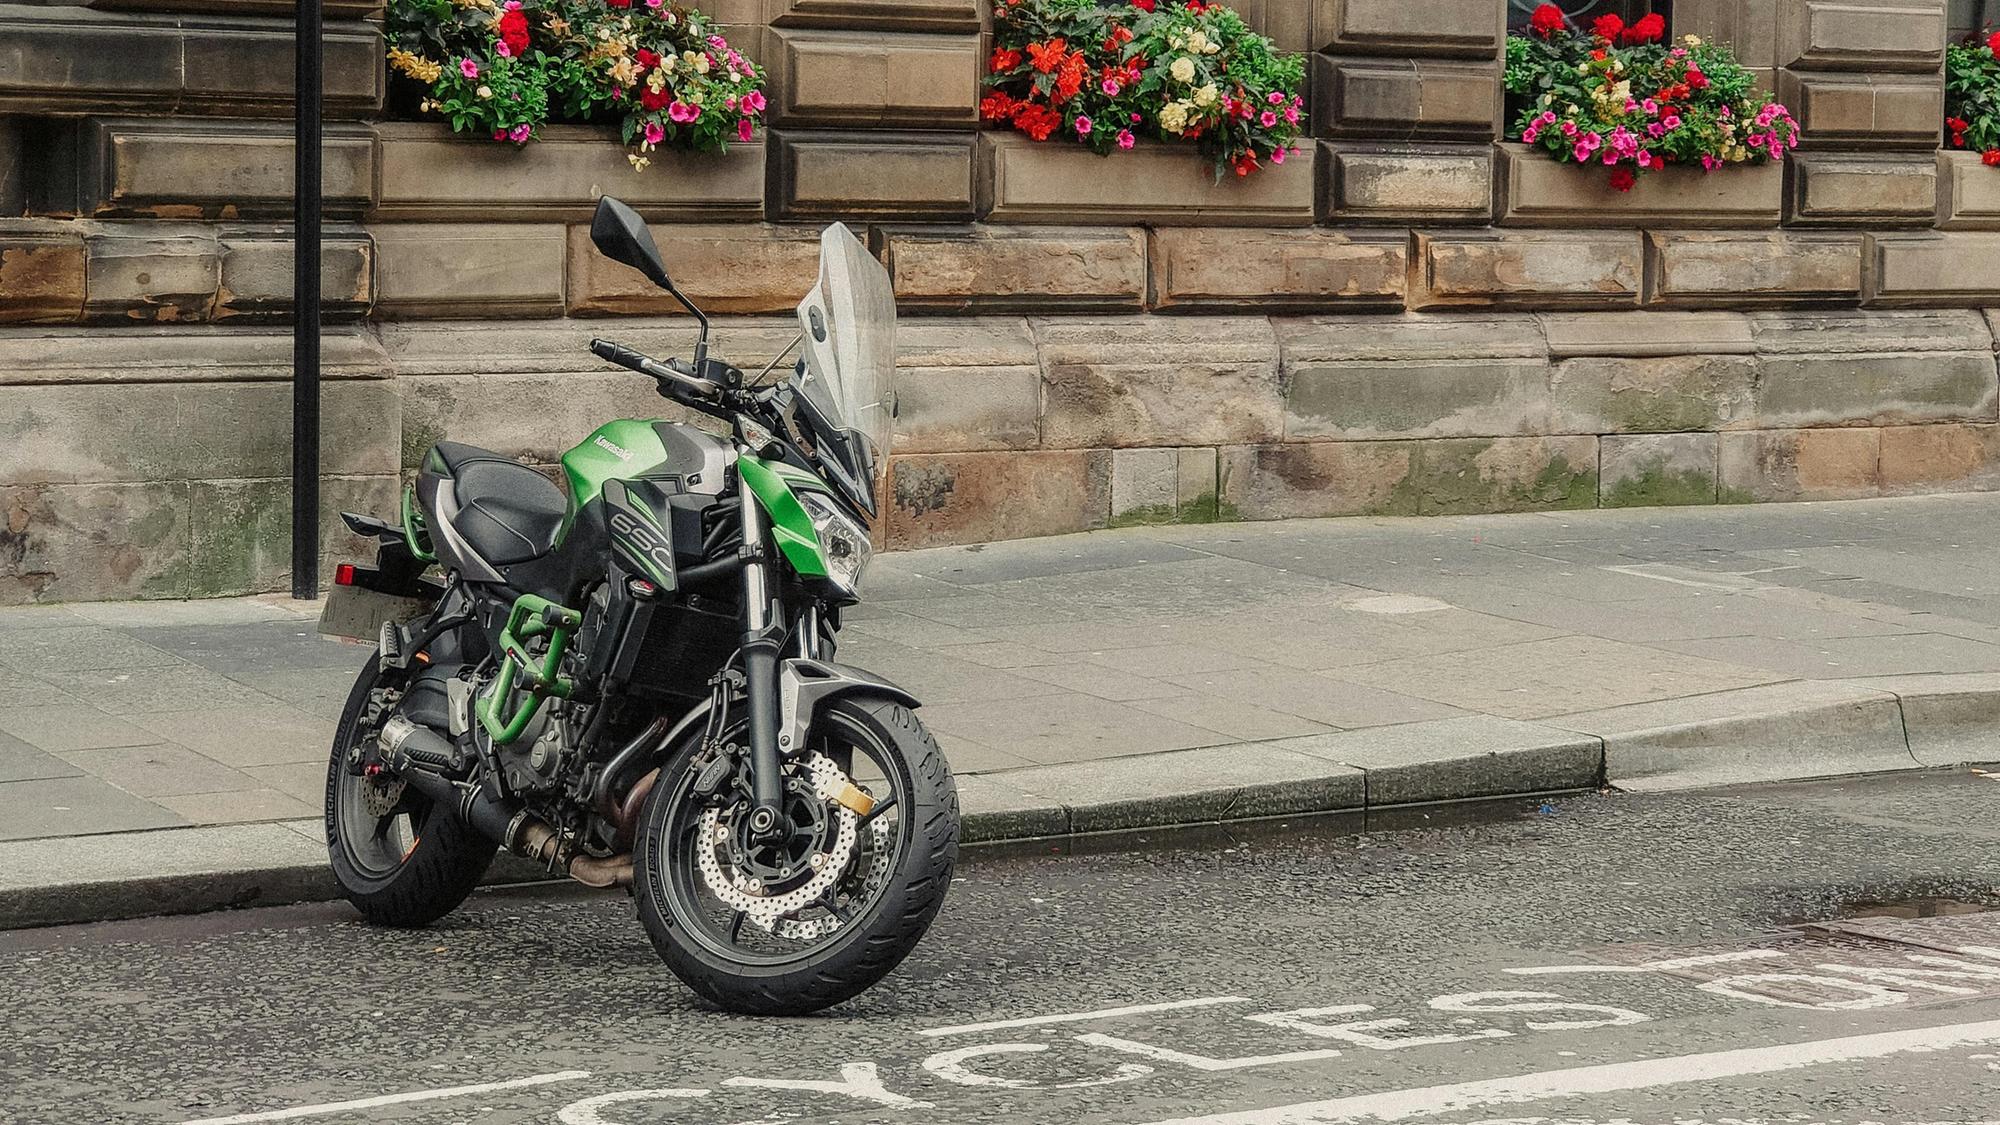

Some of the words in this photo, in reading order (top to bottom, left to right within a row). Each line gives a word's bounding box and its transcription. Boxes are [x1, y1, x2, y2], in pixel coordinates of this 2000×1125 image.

[593, 434, 634, 461] Kawasaki
[327, 763, 337, 825] MICHELIN
[650, 879, 669, 918] MICHELIN
[557, 990, 1653, 1125] CYCLES
